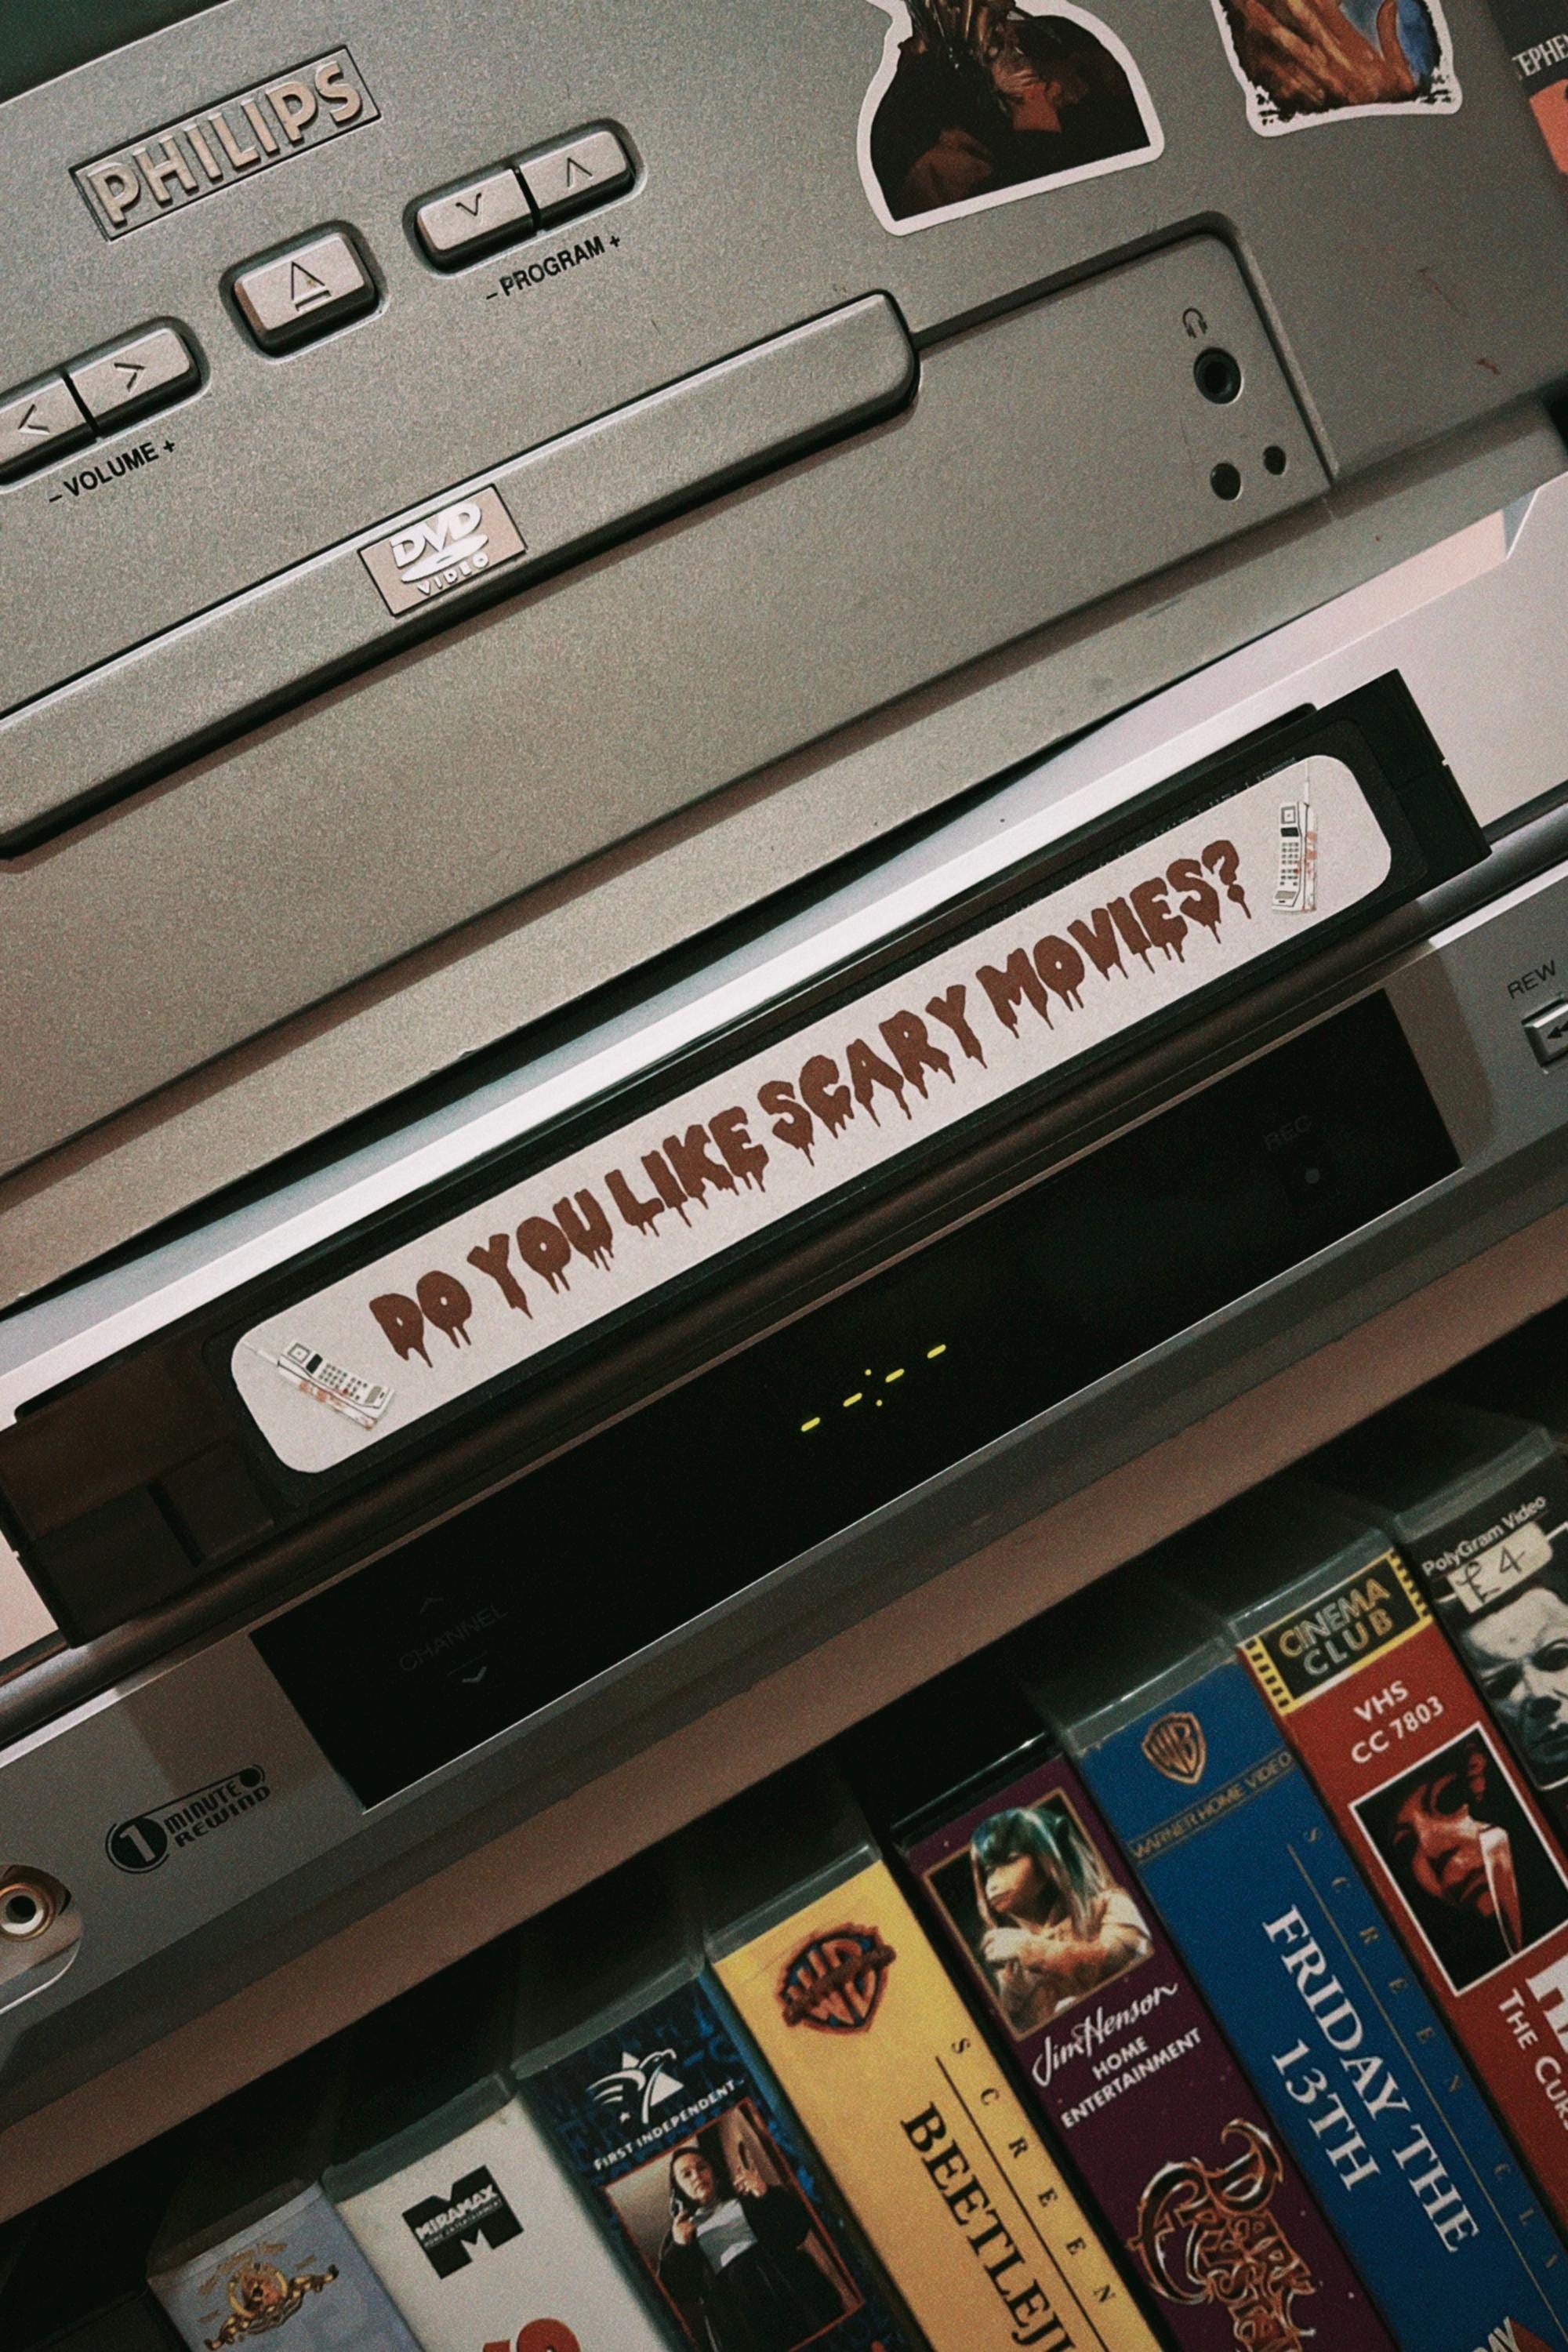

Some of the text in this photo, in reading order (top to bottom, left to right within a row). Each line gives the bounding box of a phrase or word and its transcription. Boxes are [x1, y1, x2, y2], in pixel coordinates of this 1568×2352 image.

[88, 60, 363, 227] PHILIPS
[499, 235, 605, 297] PROGRAM
[63, 441, 160, 497] VOLUME
[390, 502, 482, 568] DVD
[417, 551, 489, 595] VIDEO
[1507, 960, 1557, 1000] REW
[368, 840, 1252, 1368] DO YOU LIKE SCARY MOVIES?
[1421, 1496, 1547, 1577] PolyGram Video
[399, 1605, 509, 1671] CHANNEL
[1279, 1577, 1391, 1660] CINEMA
[1303, 1607, 1393, 1676] CLUB
[1351, 1695, 1445, 1765] CC 7803
[1353, 1679, 1410, 1722] VHS
[163, 1780, 242, 1835] MINUTE
[174, 1785, 270, 1848] REWIND
[1198, 1784, 1246, 1820] HOME
[1244, 1750, 1293, 1788] VIDEO
[1072, 1982, 1178, 2057] Henson
[1497, 1987, 1540, 2051] THE
[1061, 2027, 1204, 2129] ENTERTAINMENT
[1092, 2035, 1150, 2081] HOME
[1261, 1903, 1480, 2253] FRIDAY THE
[593, 2078, 737, 2172] FIRST INDEPENDENT
[1270, 2038, 1383, 2193] 13TH
[949, 2037, 1118, 2306] SCREEN
[415, 2183, 499, 2241] MIRAMAX
